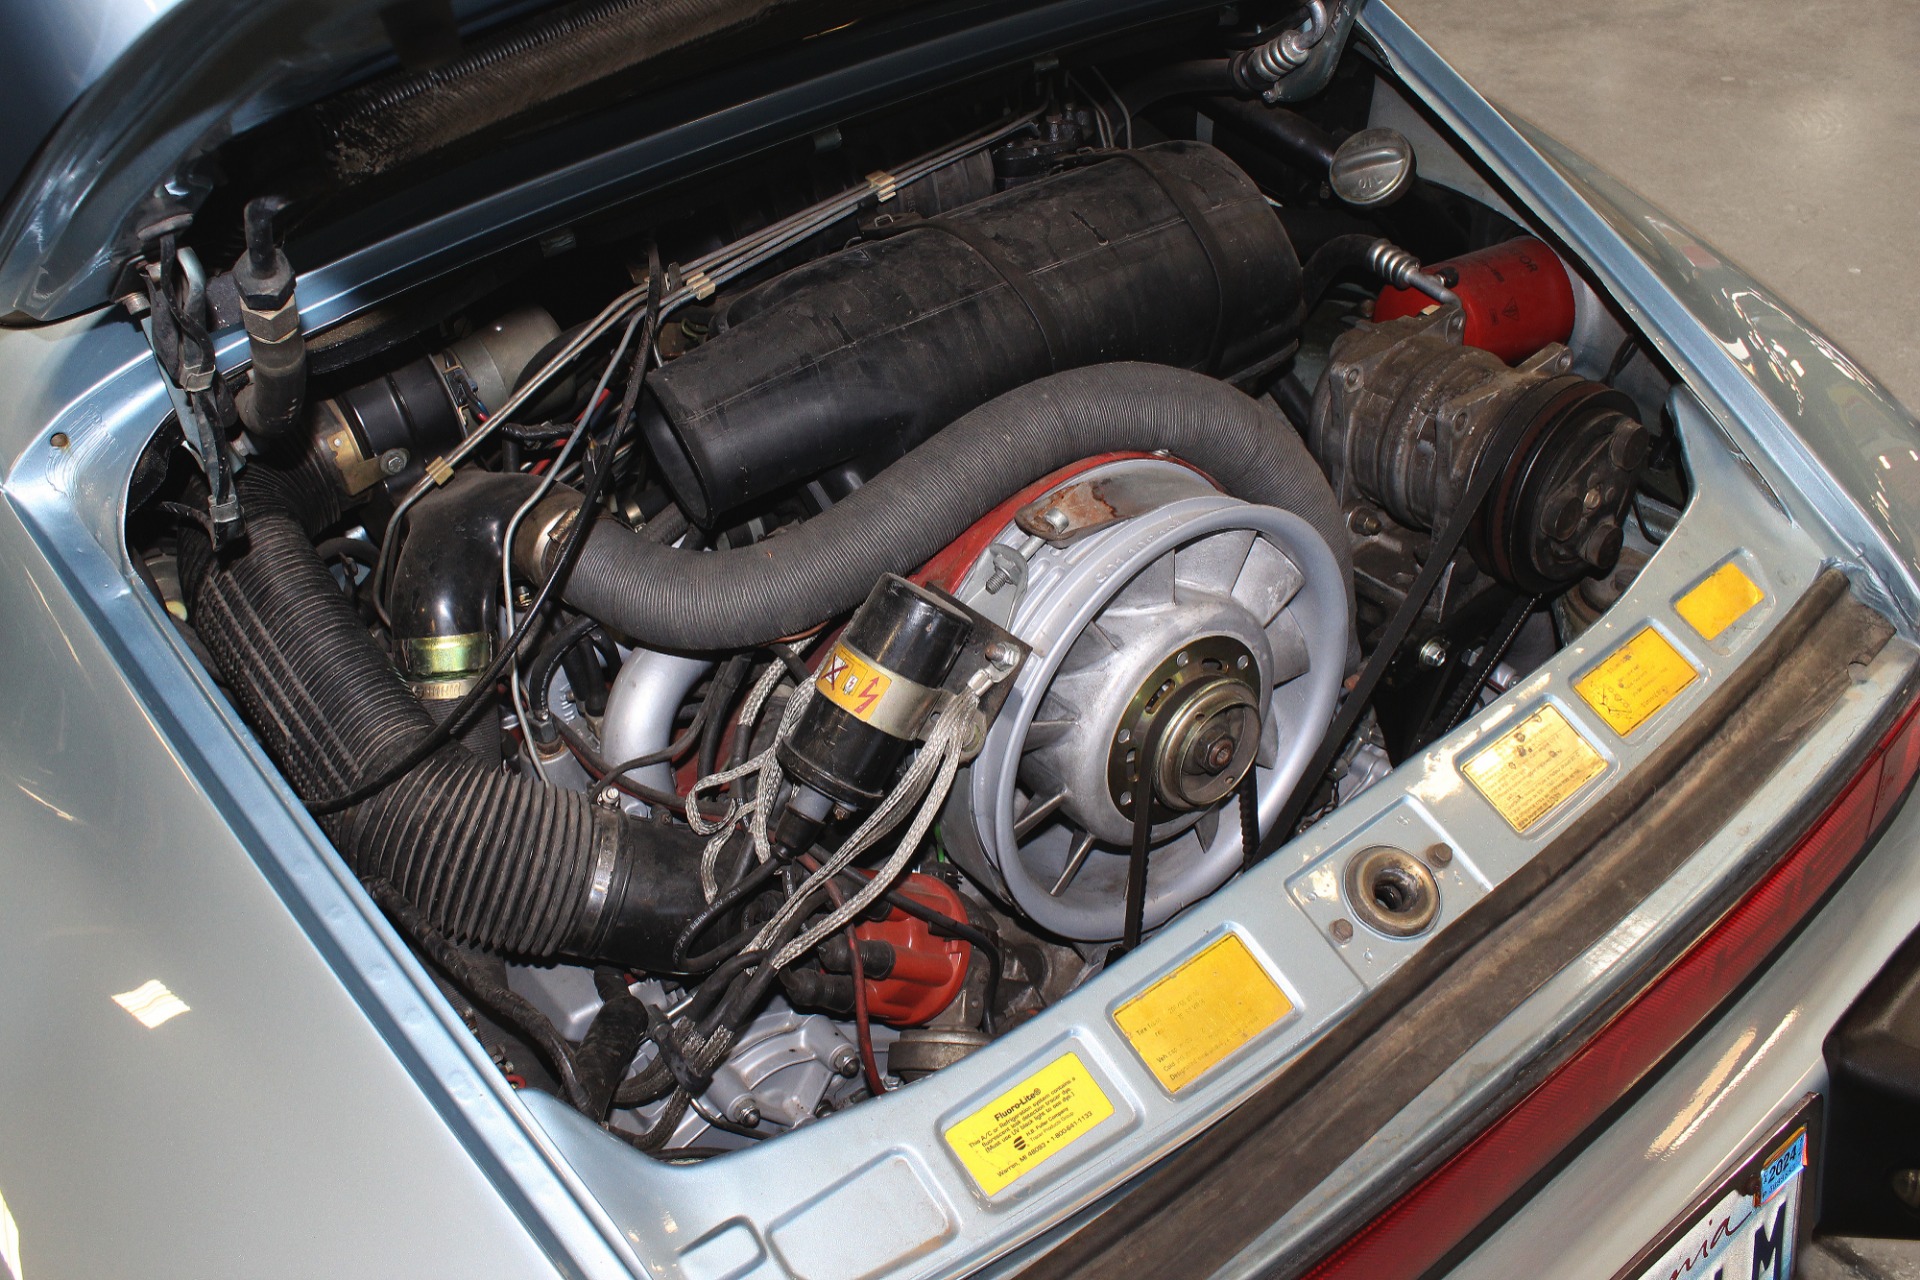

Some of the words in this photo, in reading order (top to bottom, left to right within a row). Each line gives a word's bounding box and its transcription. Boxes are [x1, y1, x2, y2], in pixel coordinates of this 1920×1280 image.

[1358, 177, 1383, 190] OIL
[969, 1139, 980, 1148] This
[981, 1132, 992, 1140] A/C
[1000, 1107, 1032, 1129] Refrigeration
[1033, 1094, 1050, 1107] system
[1051, 1080, 1071, 1095] contains
[982, 1127, 1010, 1147] fluorescent
[1011, 1121, 1021, 1129] leak
[1022, 1105, 1045, 1121] detection
[1046, 1095, 1060, 1105] tracer
[1020, 1119, 1033, 1129] black
[1034, 1111, 1045, 1121] light
[1036, 1120, 1048, 1129] Fuller
[1049, 1108, 1068, 1121] Company
[1044, 1120, 1061, 1133] Products
[1061, 1112, 1074, 1121] Group
[997, 1162, 1020, 1177] Warren,
[1768, 1148, 1798, 1184] 2024
